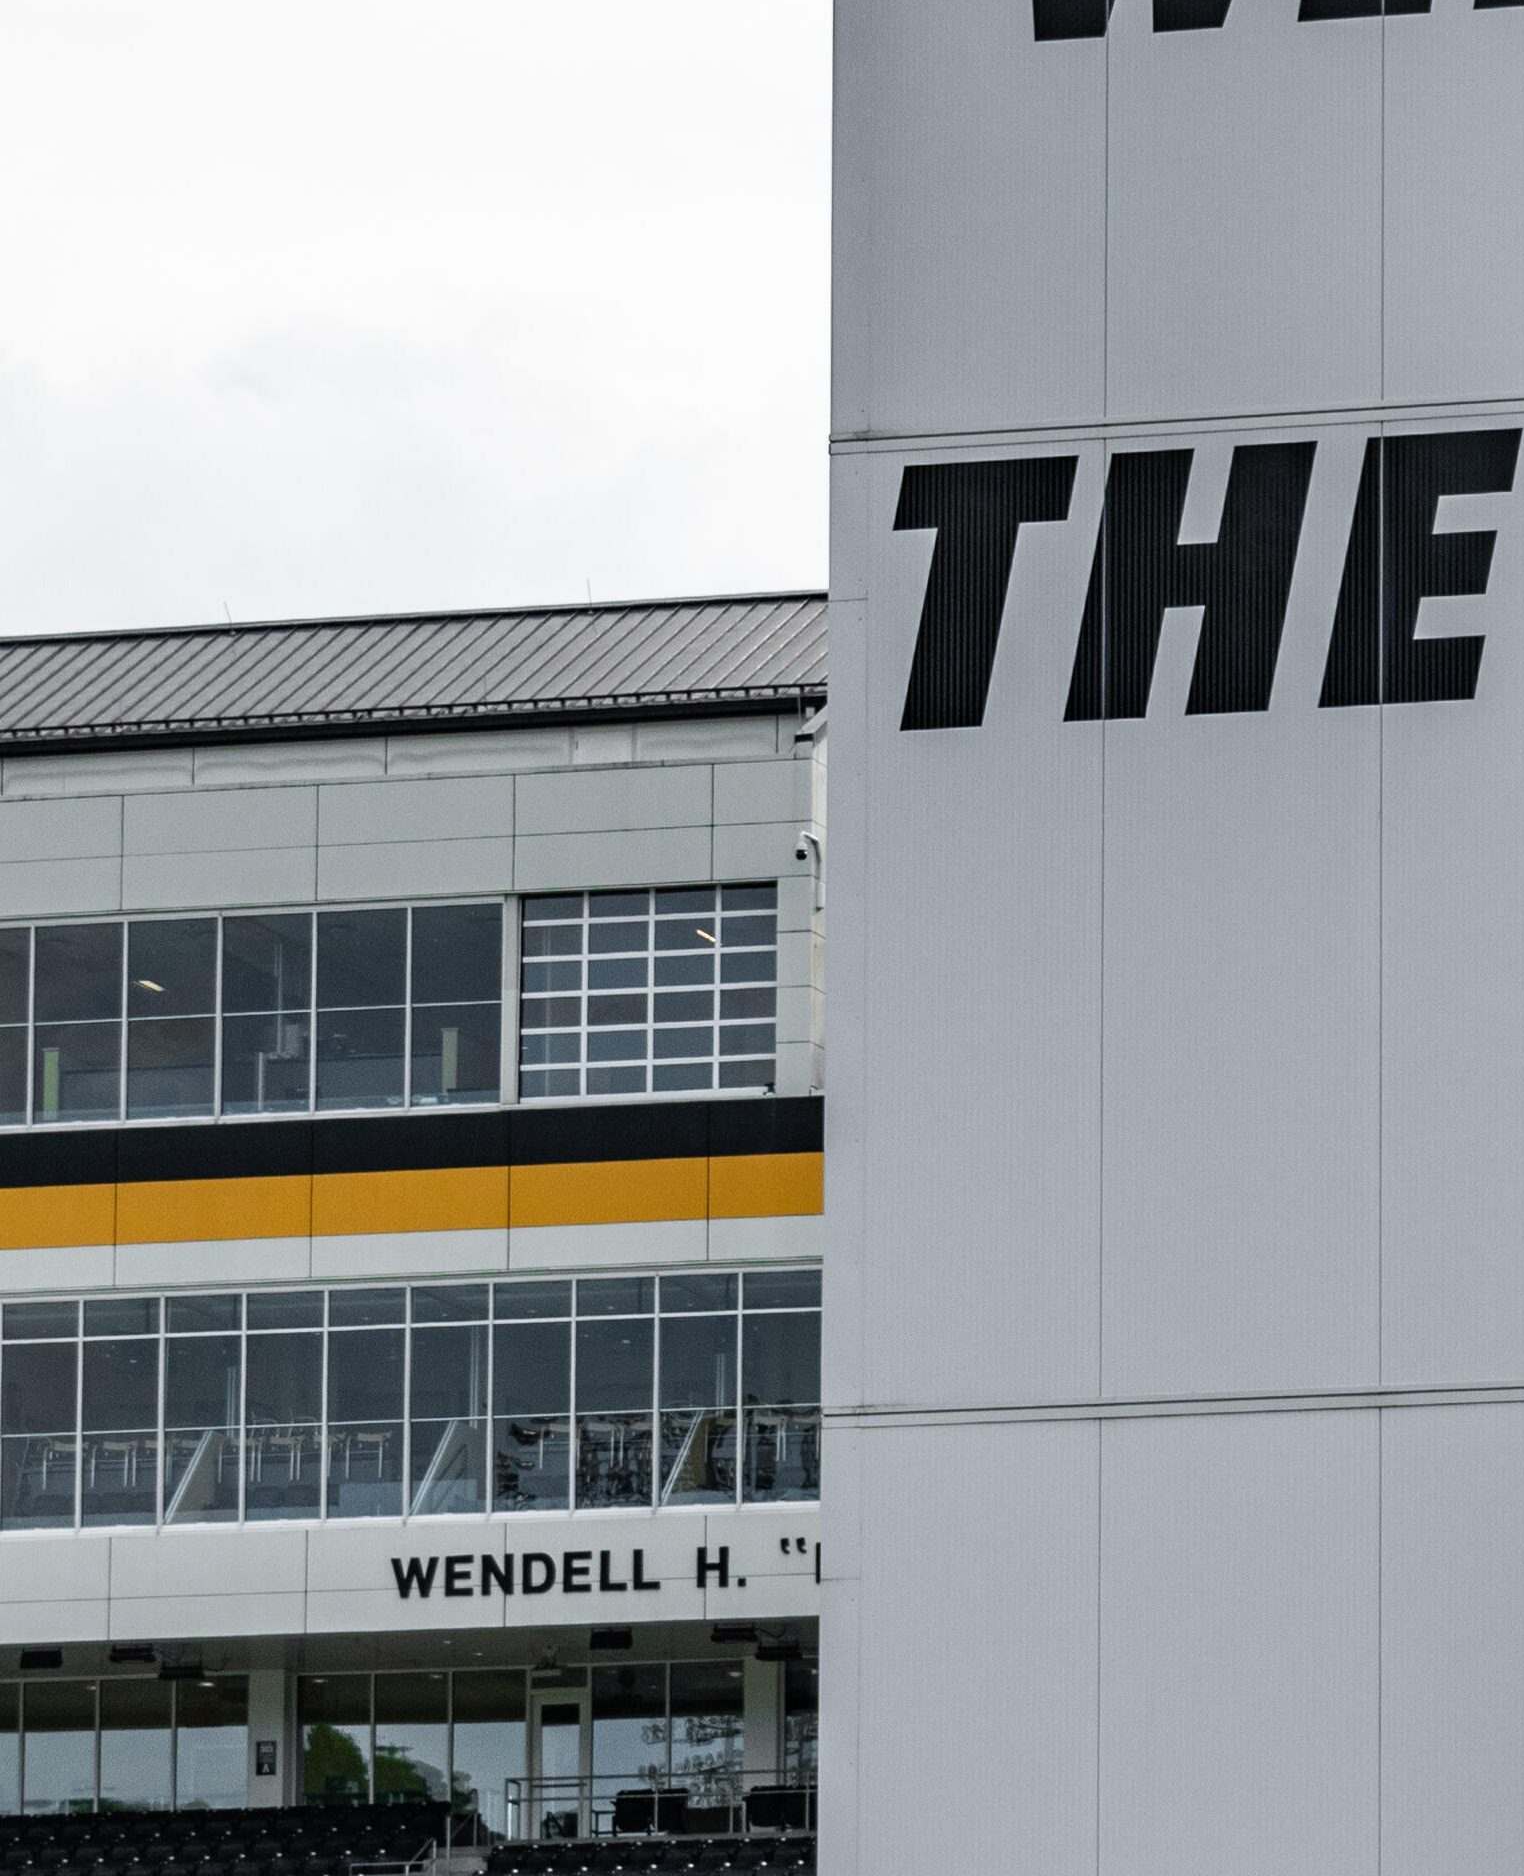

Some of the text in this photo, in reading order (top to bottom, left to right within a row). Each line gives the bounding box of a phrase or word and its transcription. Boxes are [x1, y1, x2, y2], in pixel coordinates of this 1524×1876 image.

[892, 427, 1523, 732] THE
[390, 1548, 661, 1599] WENDELL
[696, 1546, 747, 1589] H.
